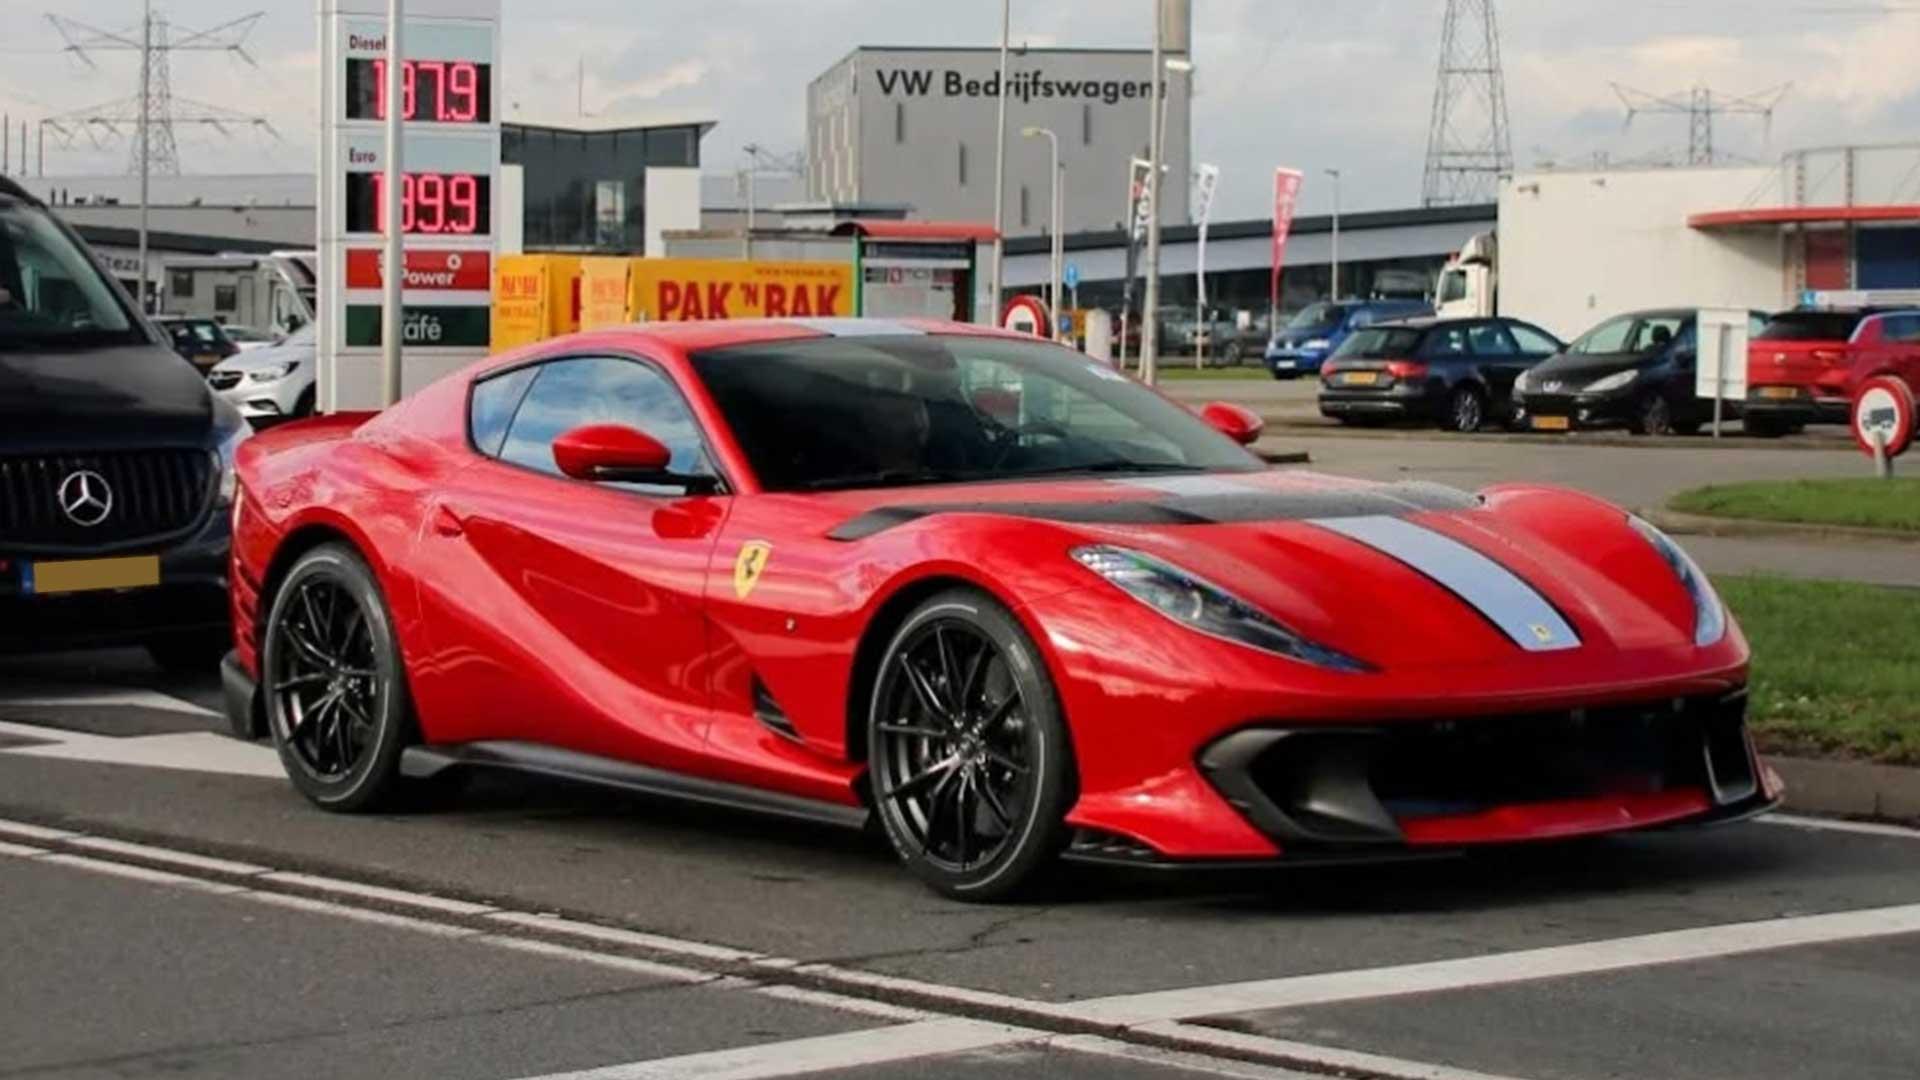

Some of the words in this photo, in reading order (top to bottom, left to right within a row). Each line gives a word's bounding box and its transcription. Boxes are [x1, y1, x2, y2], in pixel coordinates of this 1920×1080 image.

[349, 34, 387, 50] Diesel
[876, 69, 933, 96] VW
[349, 147, 377, 163] Euro
[378, 268, 456, 286] Power
[658, 280, 733, 321] PAK
[764, 283, 842, 318] BAK
[400, 314, 442, 341] afé
